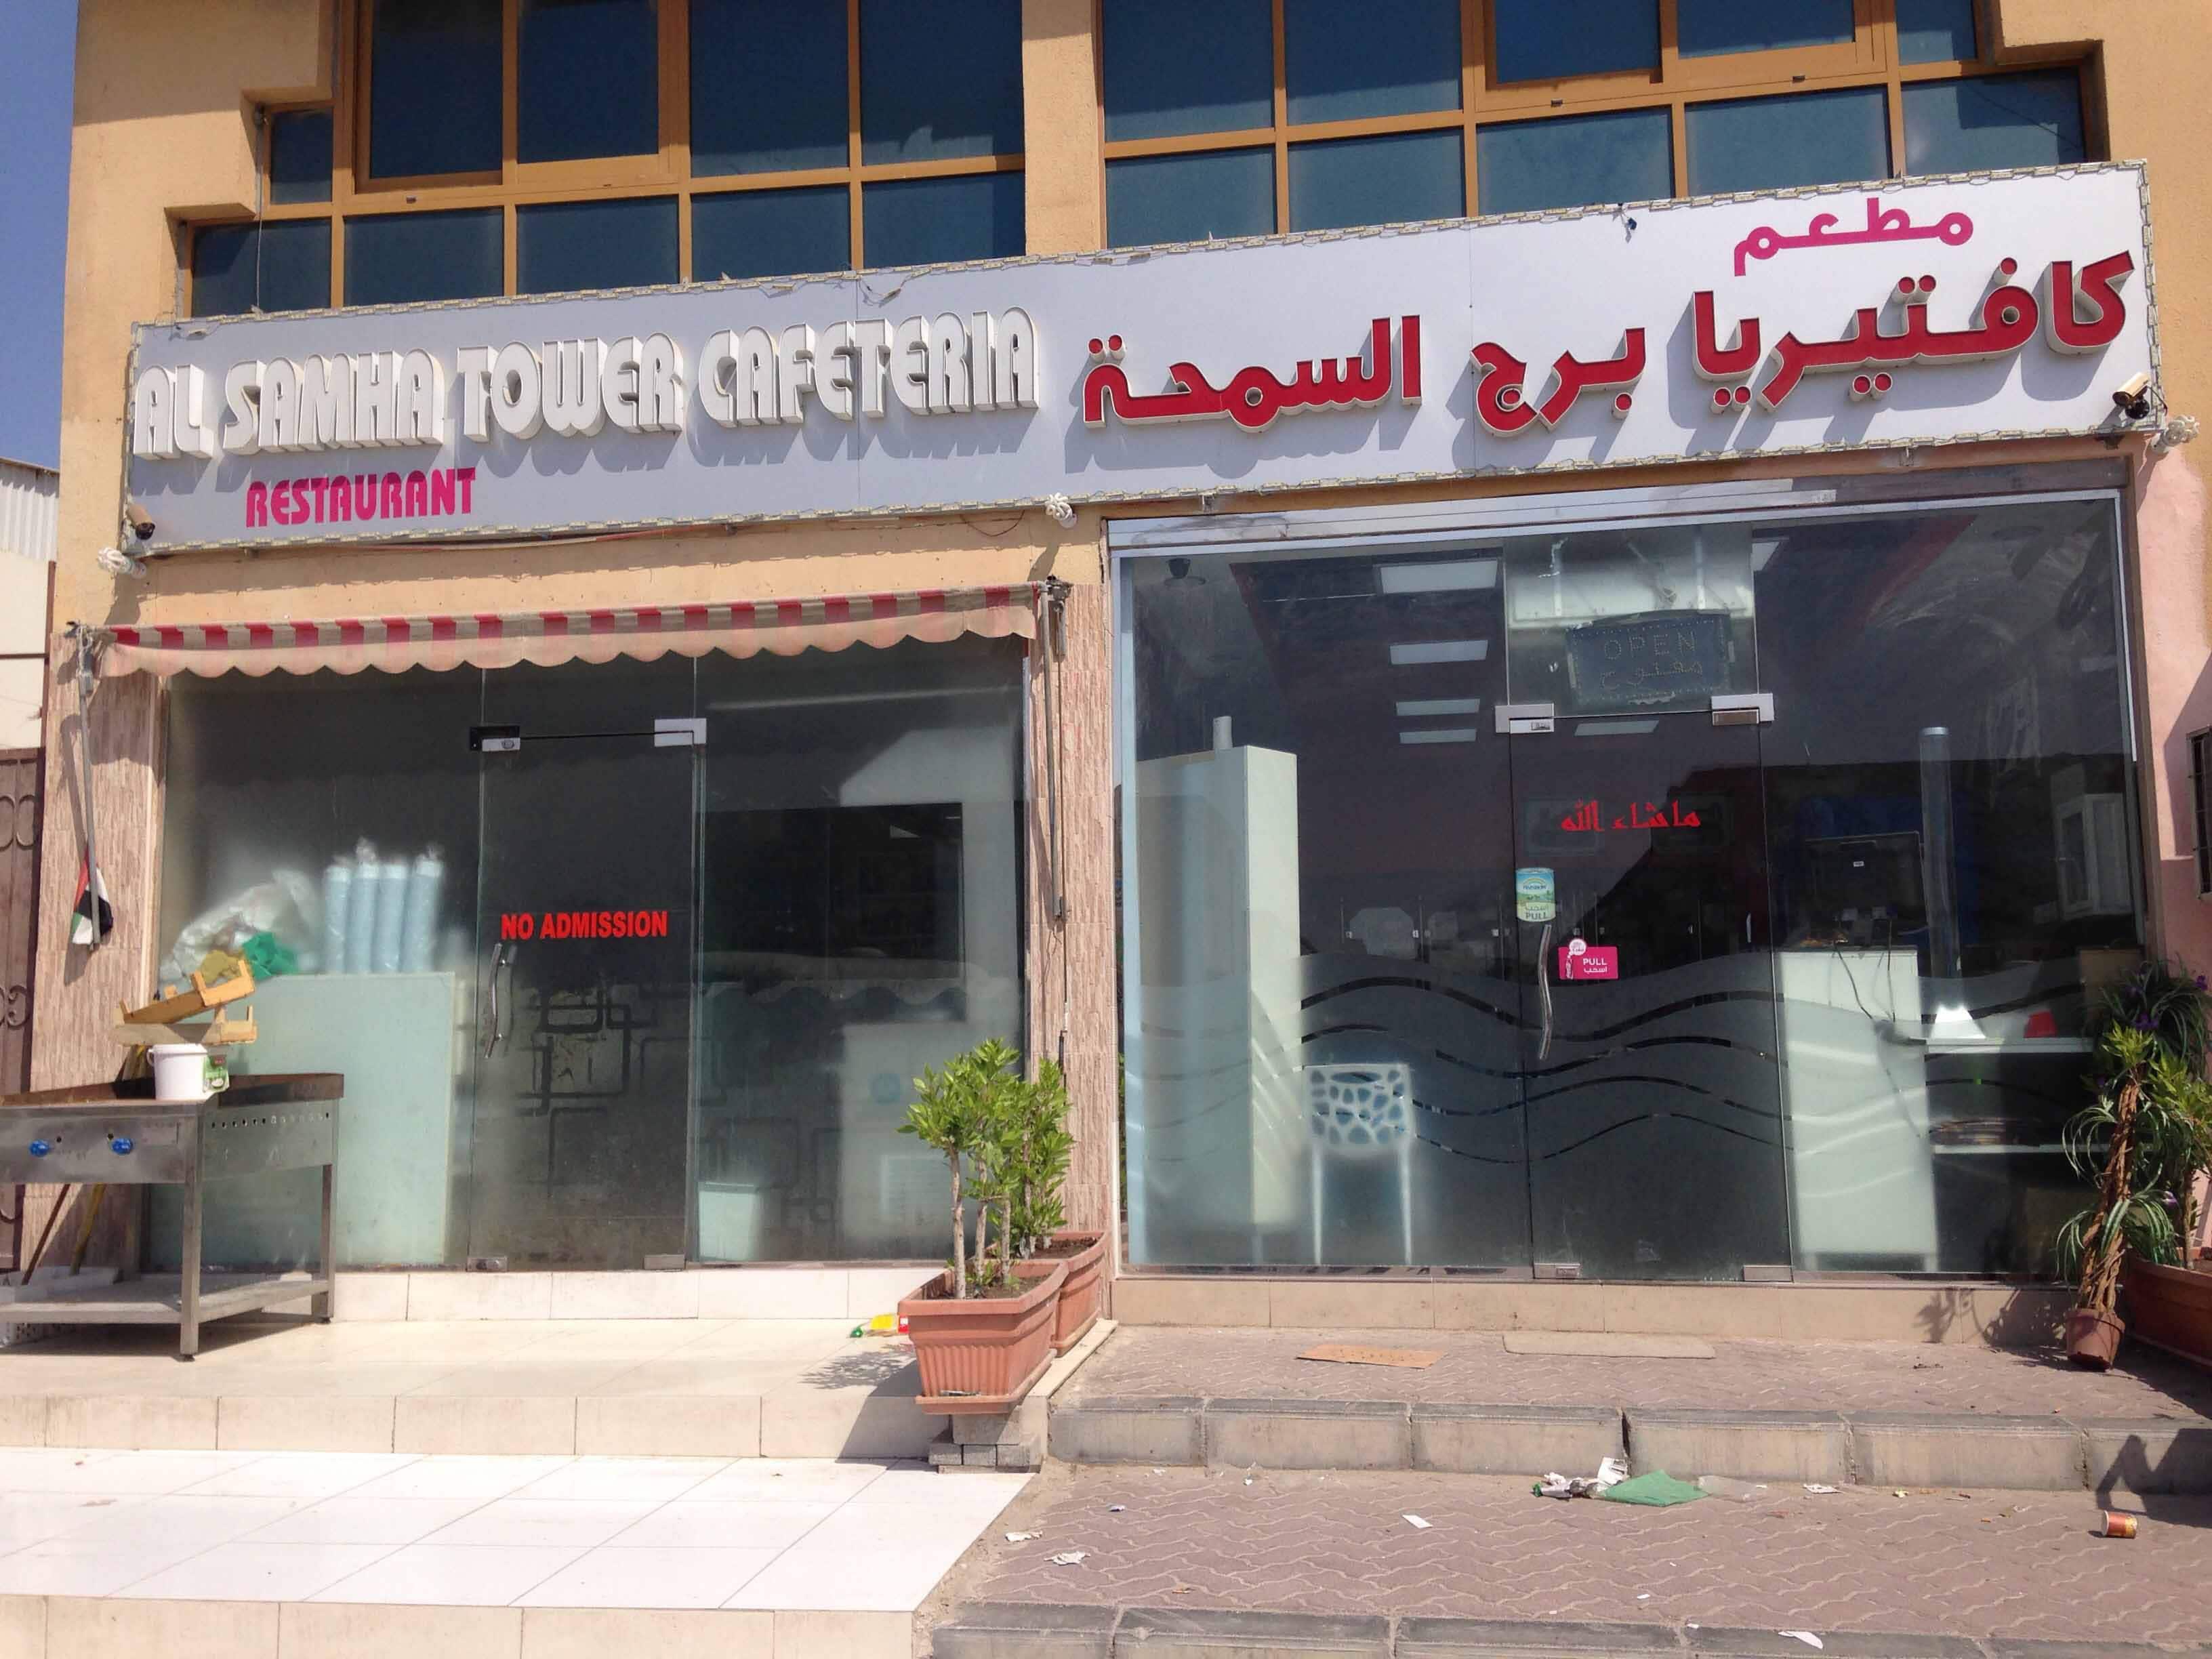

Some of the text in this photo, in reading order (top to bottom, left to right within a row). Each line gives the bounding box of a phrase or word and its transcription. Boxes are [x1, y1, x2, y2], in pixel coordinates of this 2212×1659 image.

[1734, 197, 1973, 276] مطعم
[1082, 250, 2135, 438] كافتيريا برج السمحة
[134, 306, 1040, 460] AL SAMHA TOWER CAFETERIA
[246, 467, 476, 527] RESTAURANT
[1603, 630, 1698, 661] OPEN
[500, 910, 669, 940] NO ADMISSION
[1525, 911, 1550, 920] PULL
[1582, 958, 1608, 966] PULL
[1583, 966, 1608, 975] اسحب
